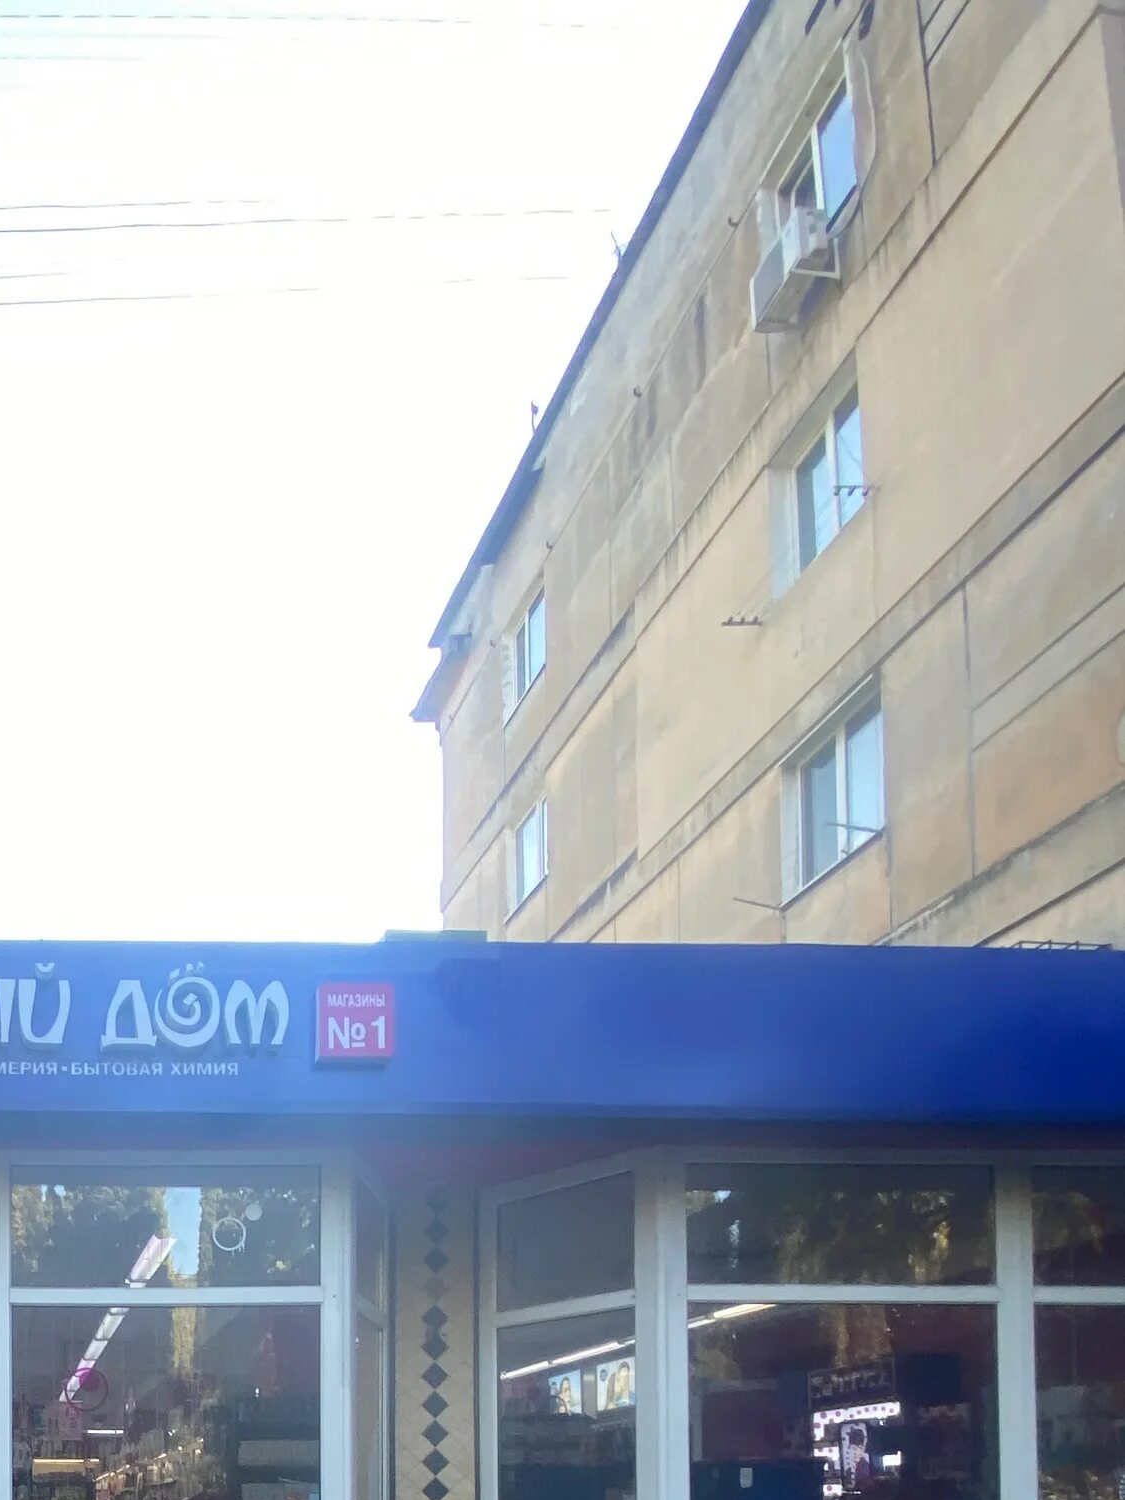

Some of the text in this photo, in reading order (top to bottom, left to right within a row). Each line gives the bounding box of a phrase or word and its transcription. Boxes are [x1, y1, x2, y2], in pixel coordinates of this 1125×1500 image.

[100, 961, 290, 1047] ДОМ
[326, 993, 386, 1008] МАГАЗИНЫ
[70, 1061, 164, 1076] БЫТОВАЯ
[170, 1062, 239, 1076] ХИМИЯ
